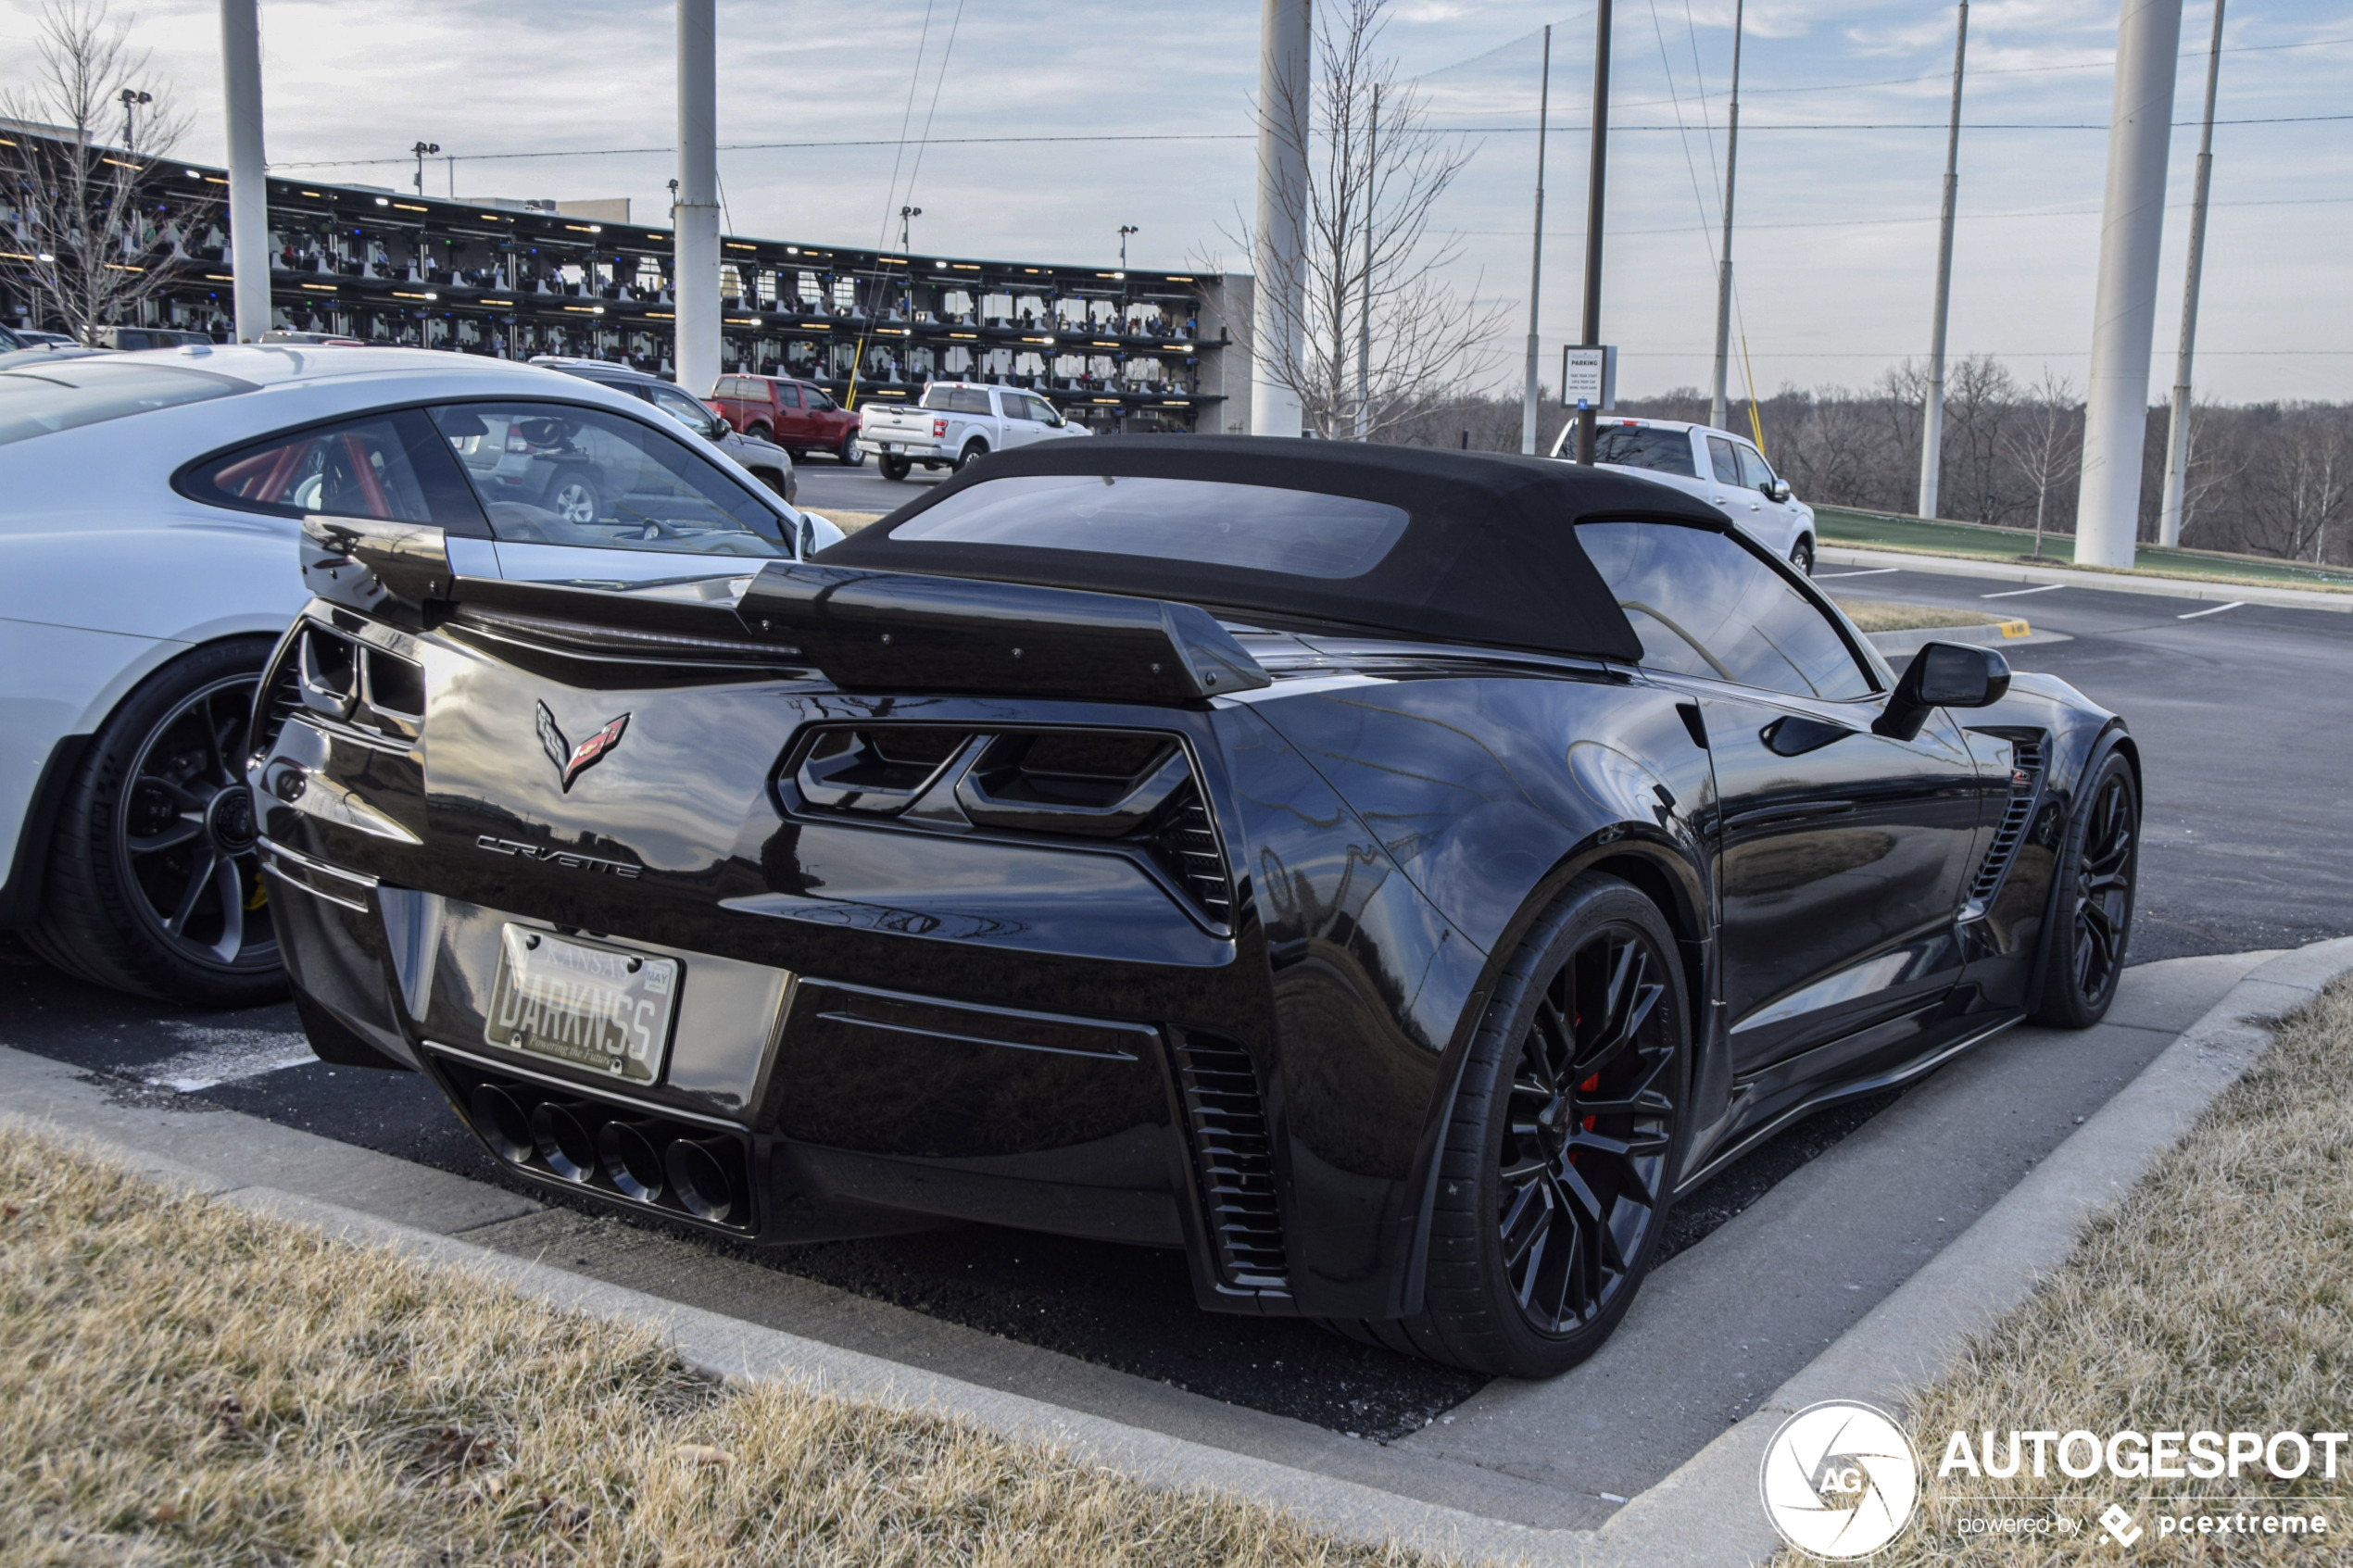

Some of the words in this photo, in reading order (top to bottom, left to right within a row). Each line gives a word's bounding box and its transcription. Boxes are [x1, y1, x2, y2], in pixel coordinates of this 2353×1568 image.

[475, 834, 645, 879] CORVETTE
[546, 940, 630, 980] KANSAS
[647, 970, 668, 985] MAY
[498, 967, 656, 1061] DARKNSS
[528, 1035, 568, 1058] Powering
[569, 1045, 584, 1058] the
